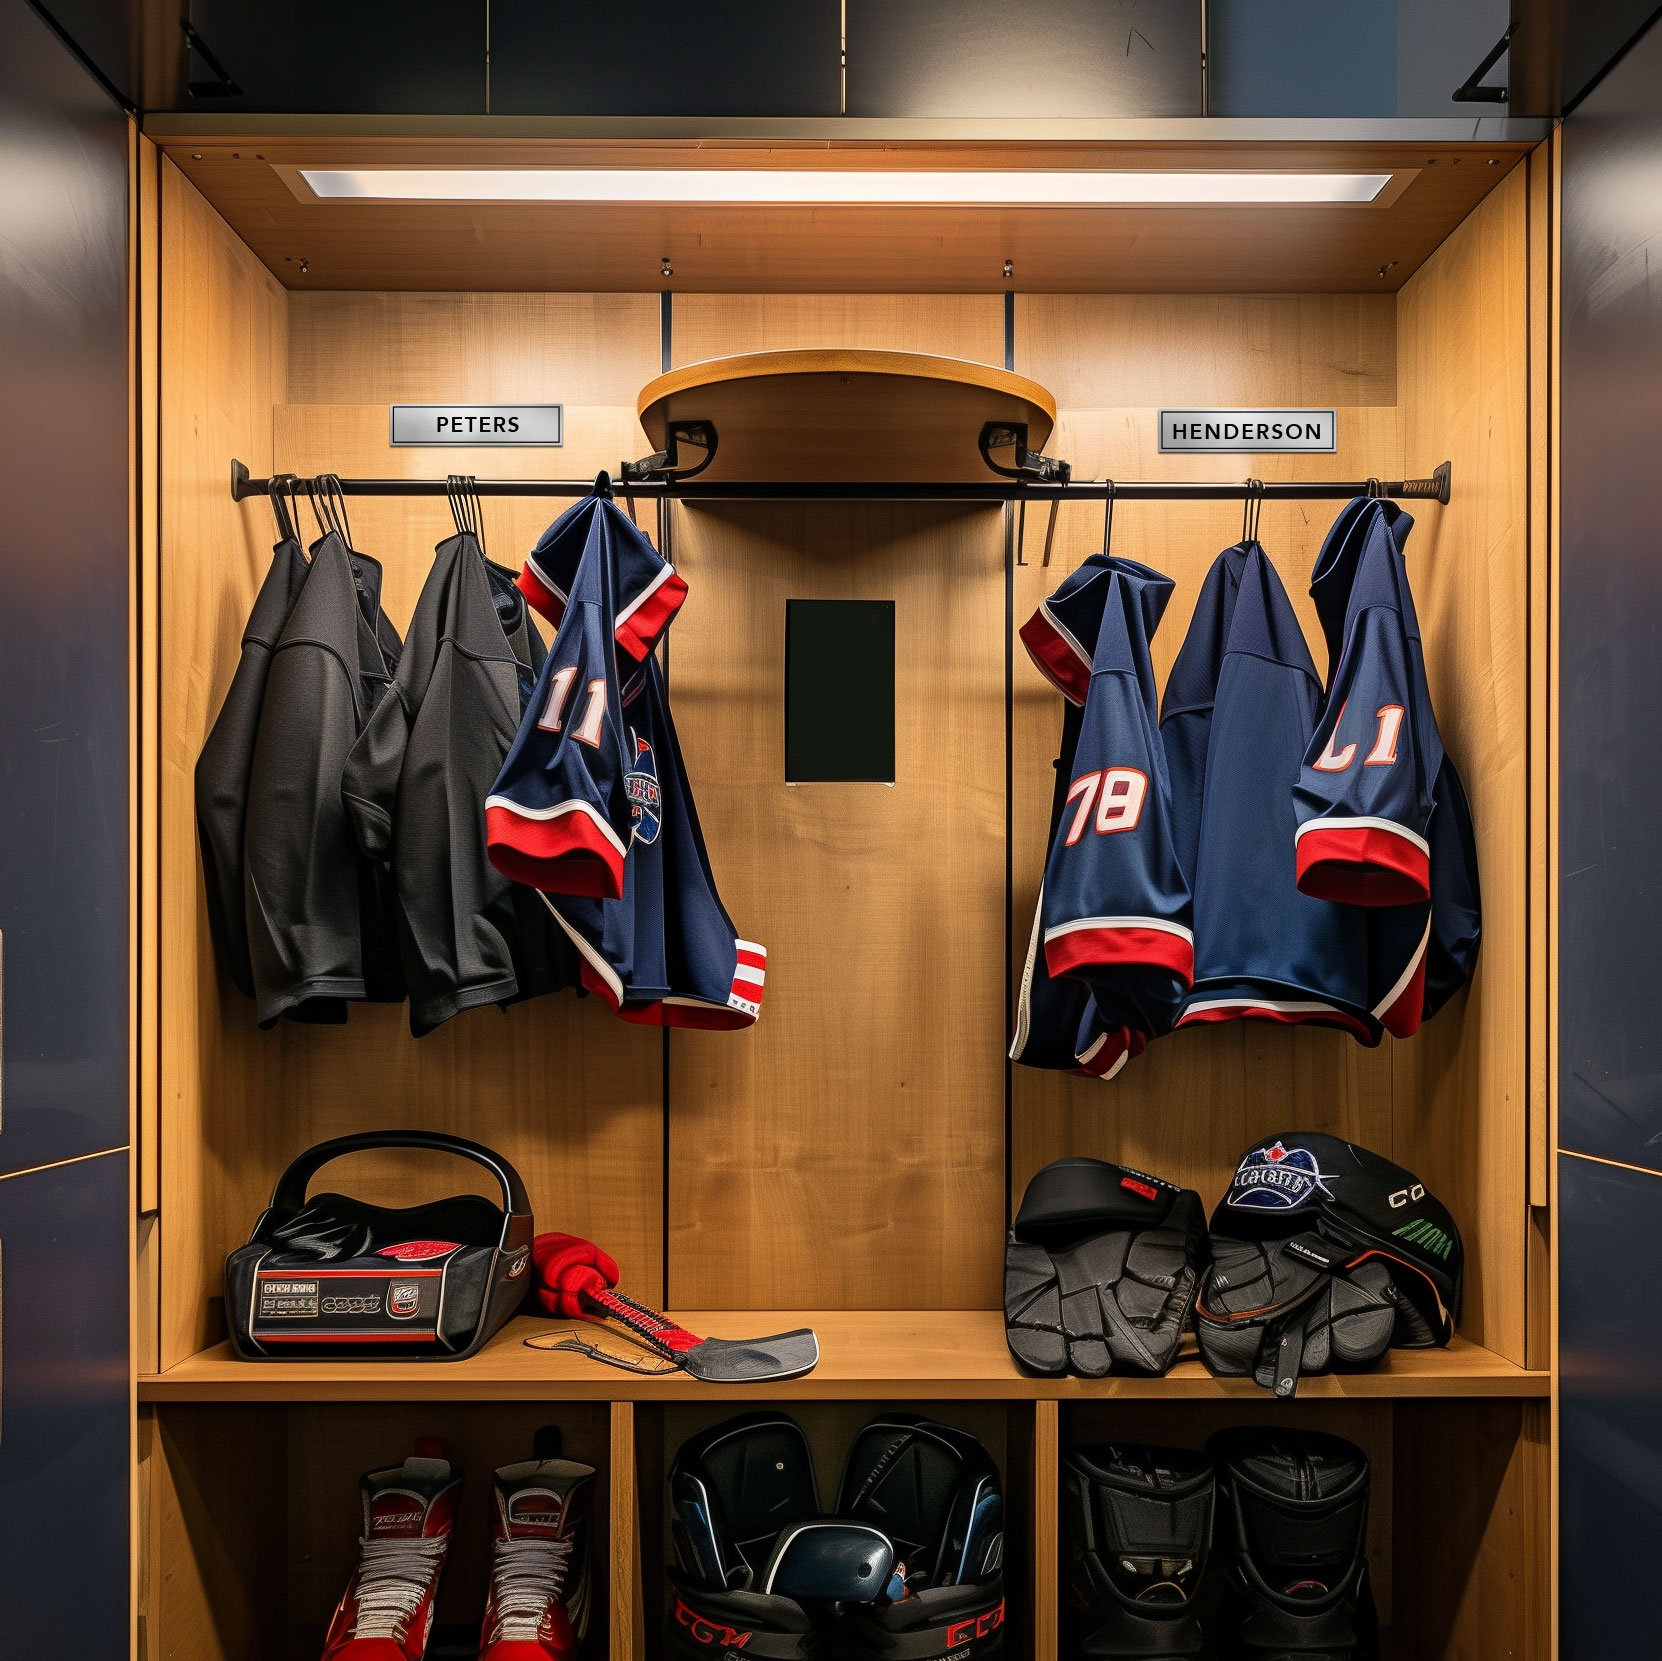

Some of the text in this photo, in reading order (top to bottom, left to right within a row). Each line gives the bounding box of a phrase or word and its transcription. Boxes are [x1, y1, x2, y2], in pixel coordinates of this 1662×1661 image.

[436, 416, 519, 433] PETERS
[1172, 423, 1321, 440] HENDERSON
[536, 666, 607, 749] 11
[1064, 766, 1149, 846] 78
